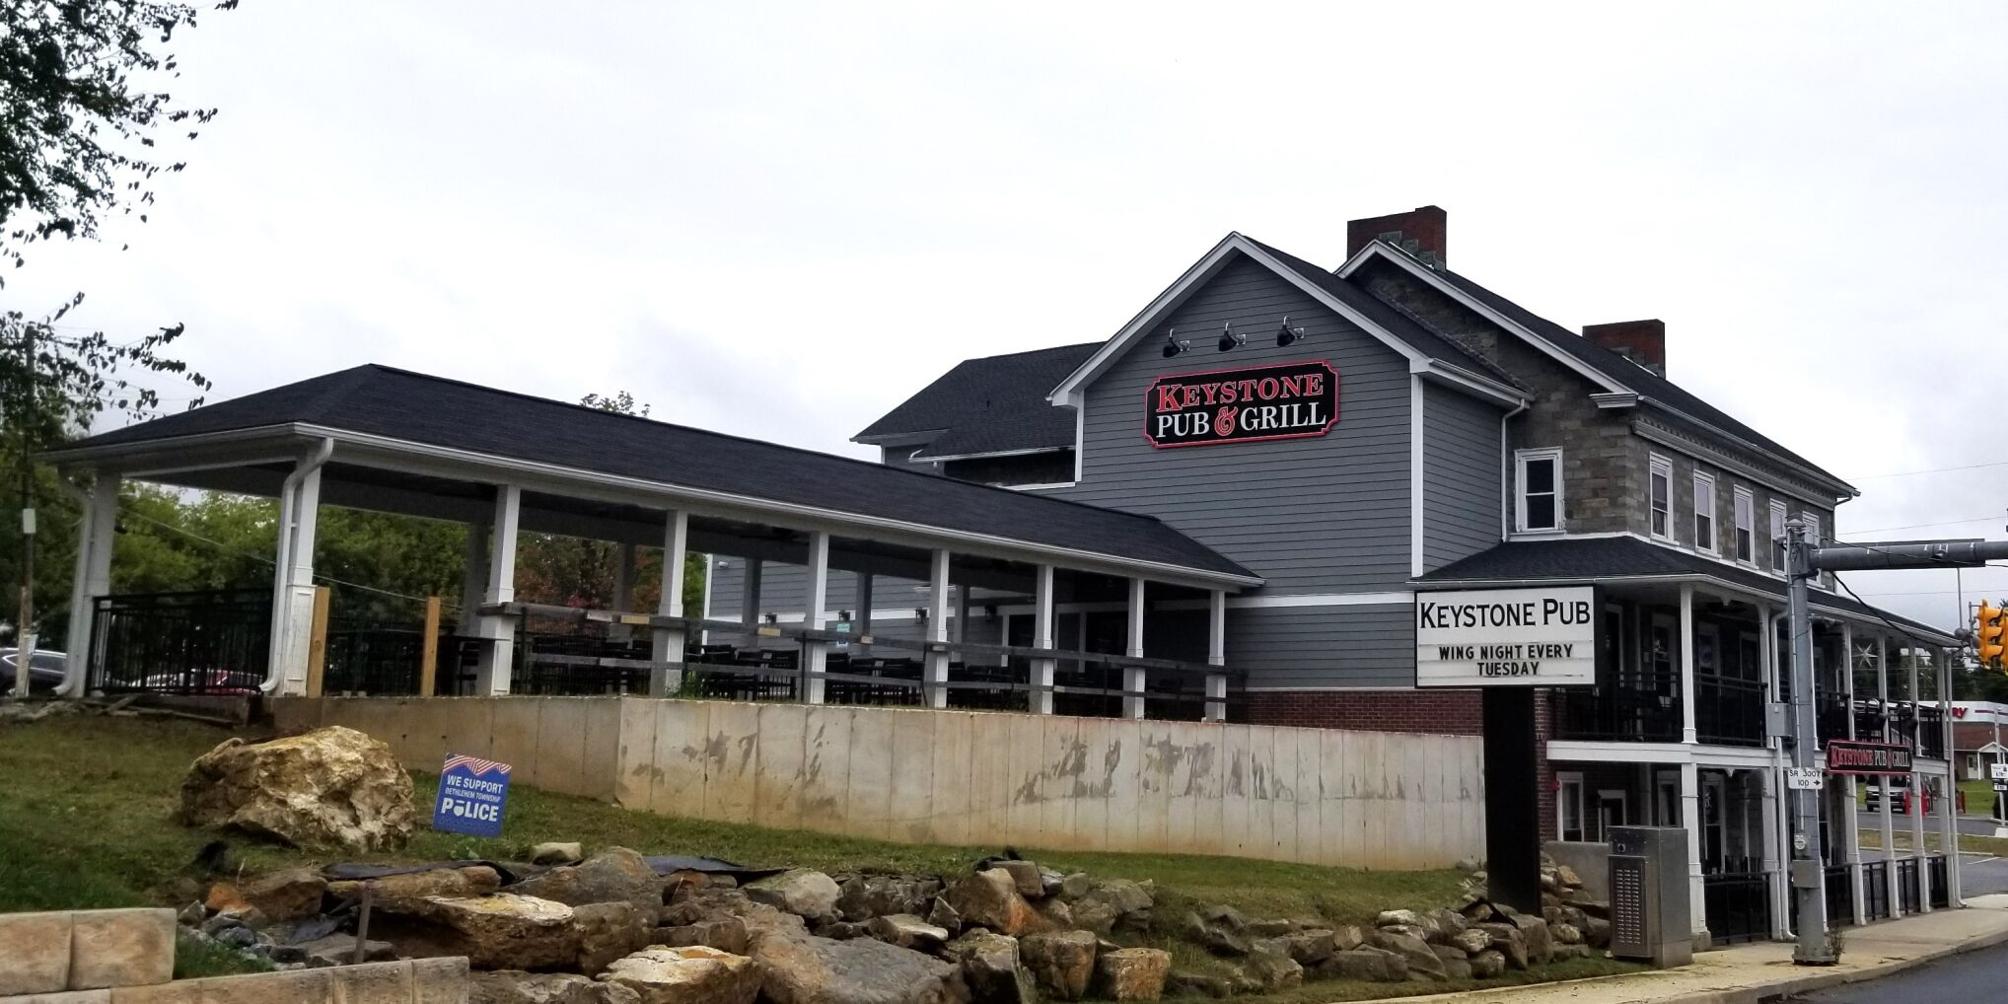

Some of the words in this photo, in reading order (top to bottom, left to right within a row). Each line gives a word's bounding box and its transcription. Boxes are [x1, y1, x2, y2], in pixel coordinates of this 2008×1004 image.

[1156, 373, 1324, 413] KEYSTONE
[1156, 411, 1210, 438] PUB
[1214, 406, 1239, 436] &
[1240, 402, 1327, 431] GRILL
[1420, 602, 1536, 629] KEYSTONE
[1542, 598, 1591, 626] PUB
[1439, 646, 1474, 660] WING
[1480, 644, 1523, 660] NIGHT
[1528, 643, 1573, 659] EVERY
[1478, 661, 1540, 676] TUESDAY
[1830, 745, 1874, 768] KEYSTONE
[1874, 749, 1887, 766] PUB
[1893, 751, 1910, 767] GRILL
[1789, 769, 1799, 777] SR
[447, 774, 462, 787] WE
[463, 777, 504, 794] SUPPORT
[476, 793, 501, 803] TOWNSHIP
[441, 797, 499, 822] POLICE
